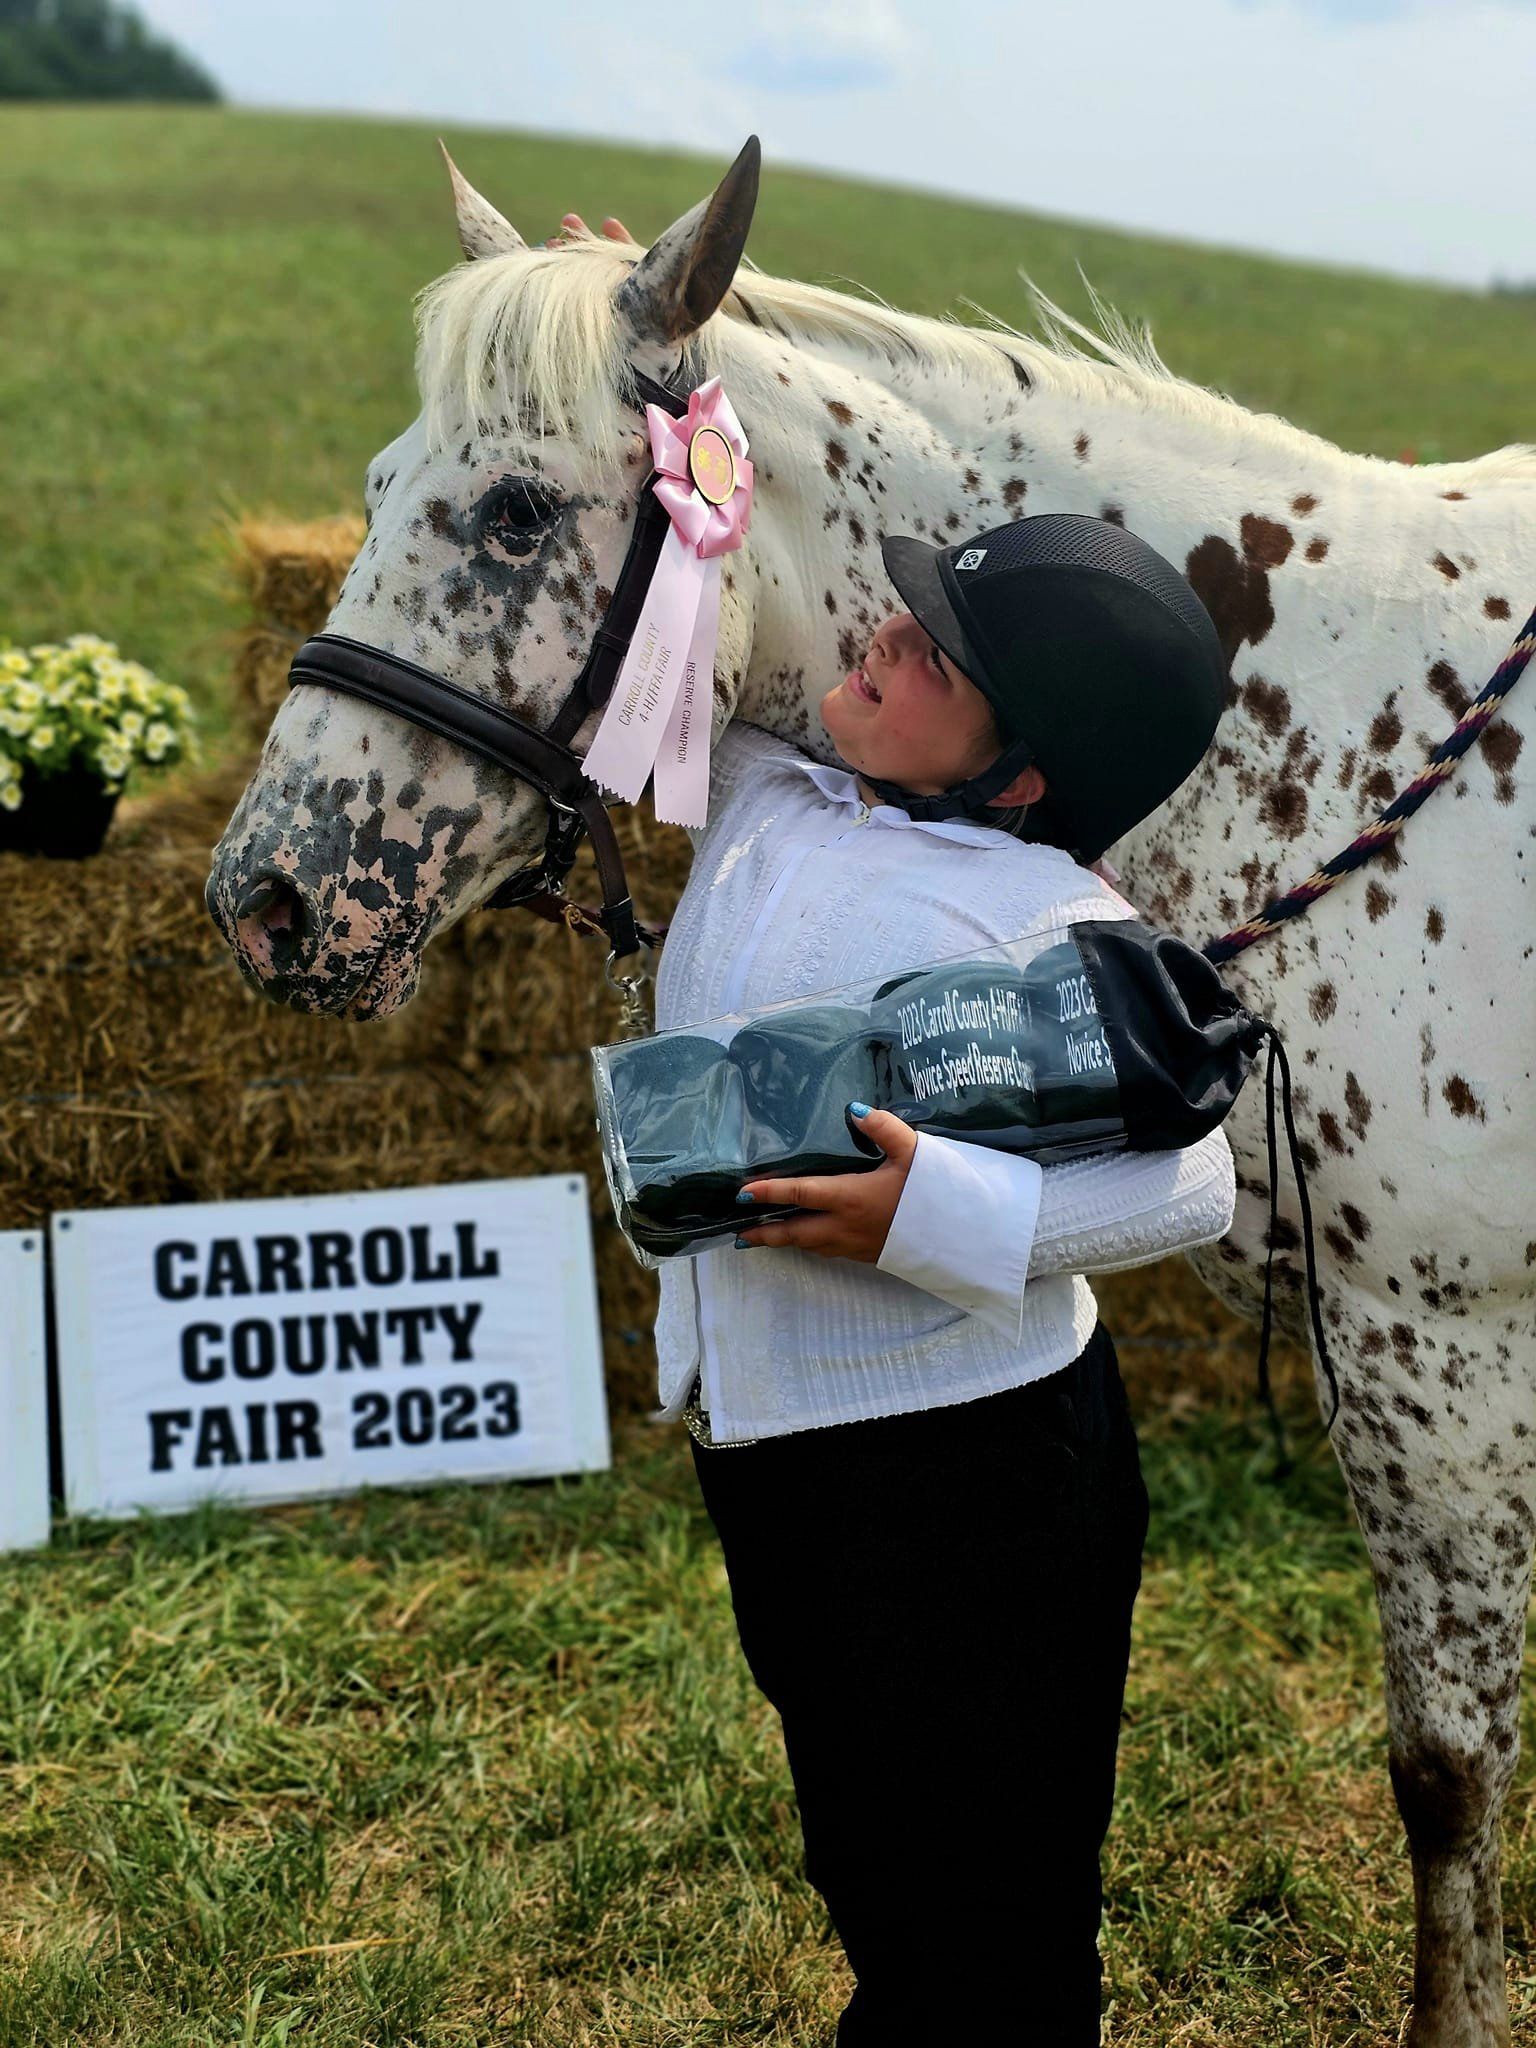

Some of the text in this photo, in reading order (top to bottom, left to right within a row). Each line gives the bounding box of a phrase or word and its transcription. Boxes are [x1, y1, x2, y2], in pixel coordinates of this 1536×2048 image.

[618, 622, 661, 726] CARROLL COUNTY
[657, 645, 672, 674] FAIR
[677, 661, 696, 764] RESERVE CHAMPION
[897, 1002, 923, 1050] 2023
[920, 991, 955, 1039] Carroll
[952, 989, 992, 1040] County
[1056, 977, 1081, 1023] 2023
[908, 1057, 944, 1103] Novice
[941, 1042, 976, 1098] Speed
[972, 1042, 1014, 1087] Reserve
[1066, 1031, 1103, 1075] Novice
[153, 1221, 499, 1301] CARROLL
[181, 1303, 483, 1384] COUNTY
[148, 1381, 521, 1473] FAIR 2023
